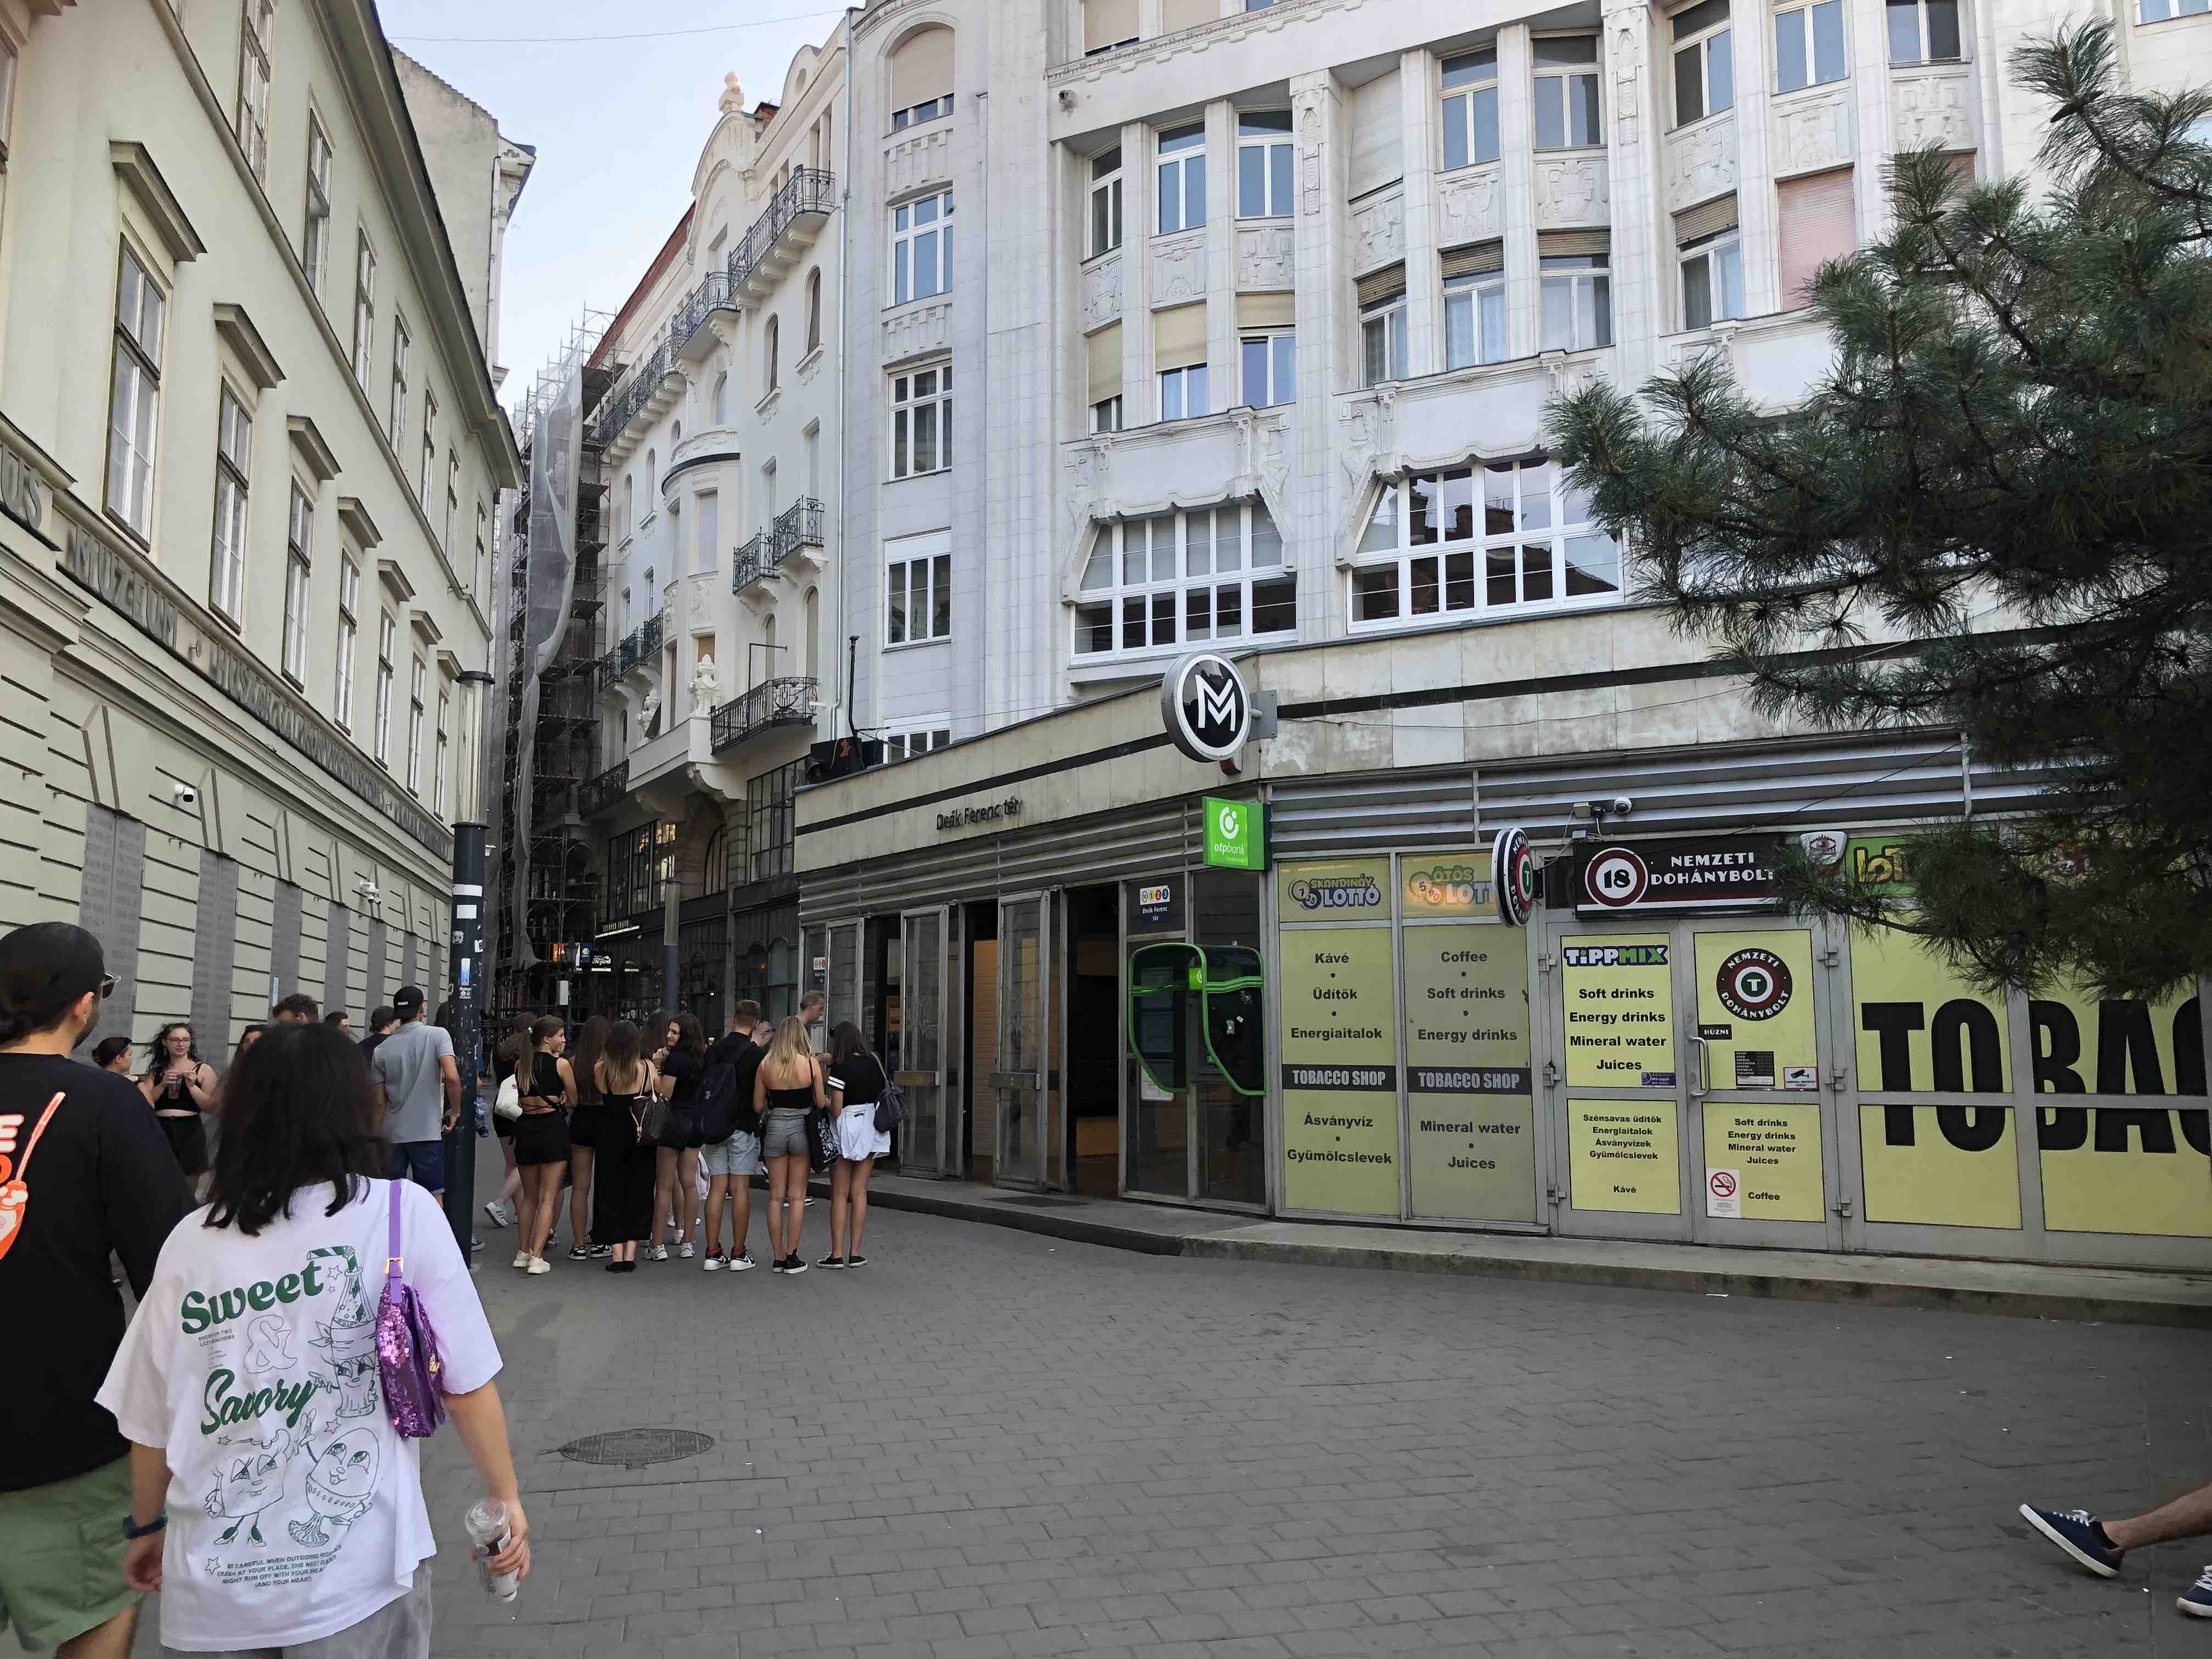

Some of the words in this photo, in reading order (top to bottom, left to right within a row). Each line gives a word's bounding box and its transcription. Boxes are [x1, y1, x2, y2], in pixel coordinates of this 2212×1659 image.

[964, 804, 1002, 824] Ferenc
[1214, 843, 1245, 855] otpbank
[1671, 851, 1754, 867] NEMZETI
[1604, 869, 1630, 888] 18
[1446, 883, 1493, 905] LOTT
[1315, 952, 1349, 963] Kávé
[1441, 951, 1488, 962] Coffee
[1726, 952, 1780, 969] NEMZETI
[1747, 979, 1761, 991] T
[1427, 988, 1456, 999] Soft
[1460, 988, 1506, 999] drinks
[1579, 988, 1607, 999] Soft
[1611, 988, 1655, 999] drinks
[1721, 990, 1788, 1018] DOHÁNYBOLT
[1570, 1012, 1618, 1025] Energy
[1622, 1012, 1666, 1022] drinks
[1291, 1028, 1383, 1041] Energiaitalok
[1418, 1029, 1468, 1043] Energy
[1472, 1029, 1518, 1041] drinks
[1570, 1036, 1621, 1046] Mineral
[1626, 1036, 1667, 1047] water
[1596, 1059, 1642, 1070] Juices
[1293, 1070, 1350, 1085] TOBACCO
[1352, 1070, 1386, 1086] SHOP
[1418, 1072, 1481, 1088] TOBACCO
[1483, 1073, 1520, 1089] SHOP
[1304, 1112, 1374, 1129] Ásványvíz
[1583, 1114, 1630, 1122] Szénsavas
[1420, 1120, 1474, 1133] Mineral
[1479, 1122, 1521, 1135] water
[1593, 1126, 1653, 1136] Energiaitalok
[1728, 1131, 1762, 1141] Energy
[1764, 1132, 1796, 1140] drinks
[1728, 1143, 1764, 1152] Mineral
[1287, 1149, 1392, 1164] Gyümölcslevek
[1589, 1150, 1658, 1159] Gyümölcslevek
[1746, 1156, 1779, 1165] Juices
[1448, 1156, 1496, 1170] Juices
[1748, 1192, 1780, 1200] Coffee
[182, 1260, 324, 1334] Sweet
[244, 1314, 297, 1374] &
[201, 1369, 317, 1434] Savory
